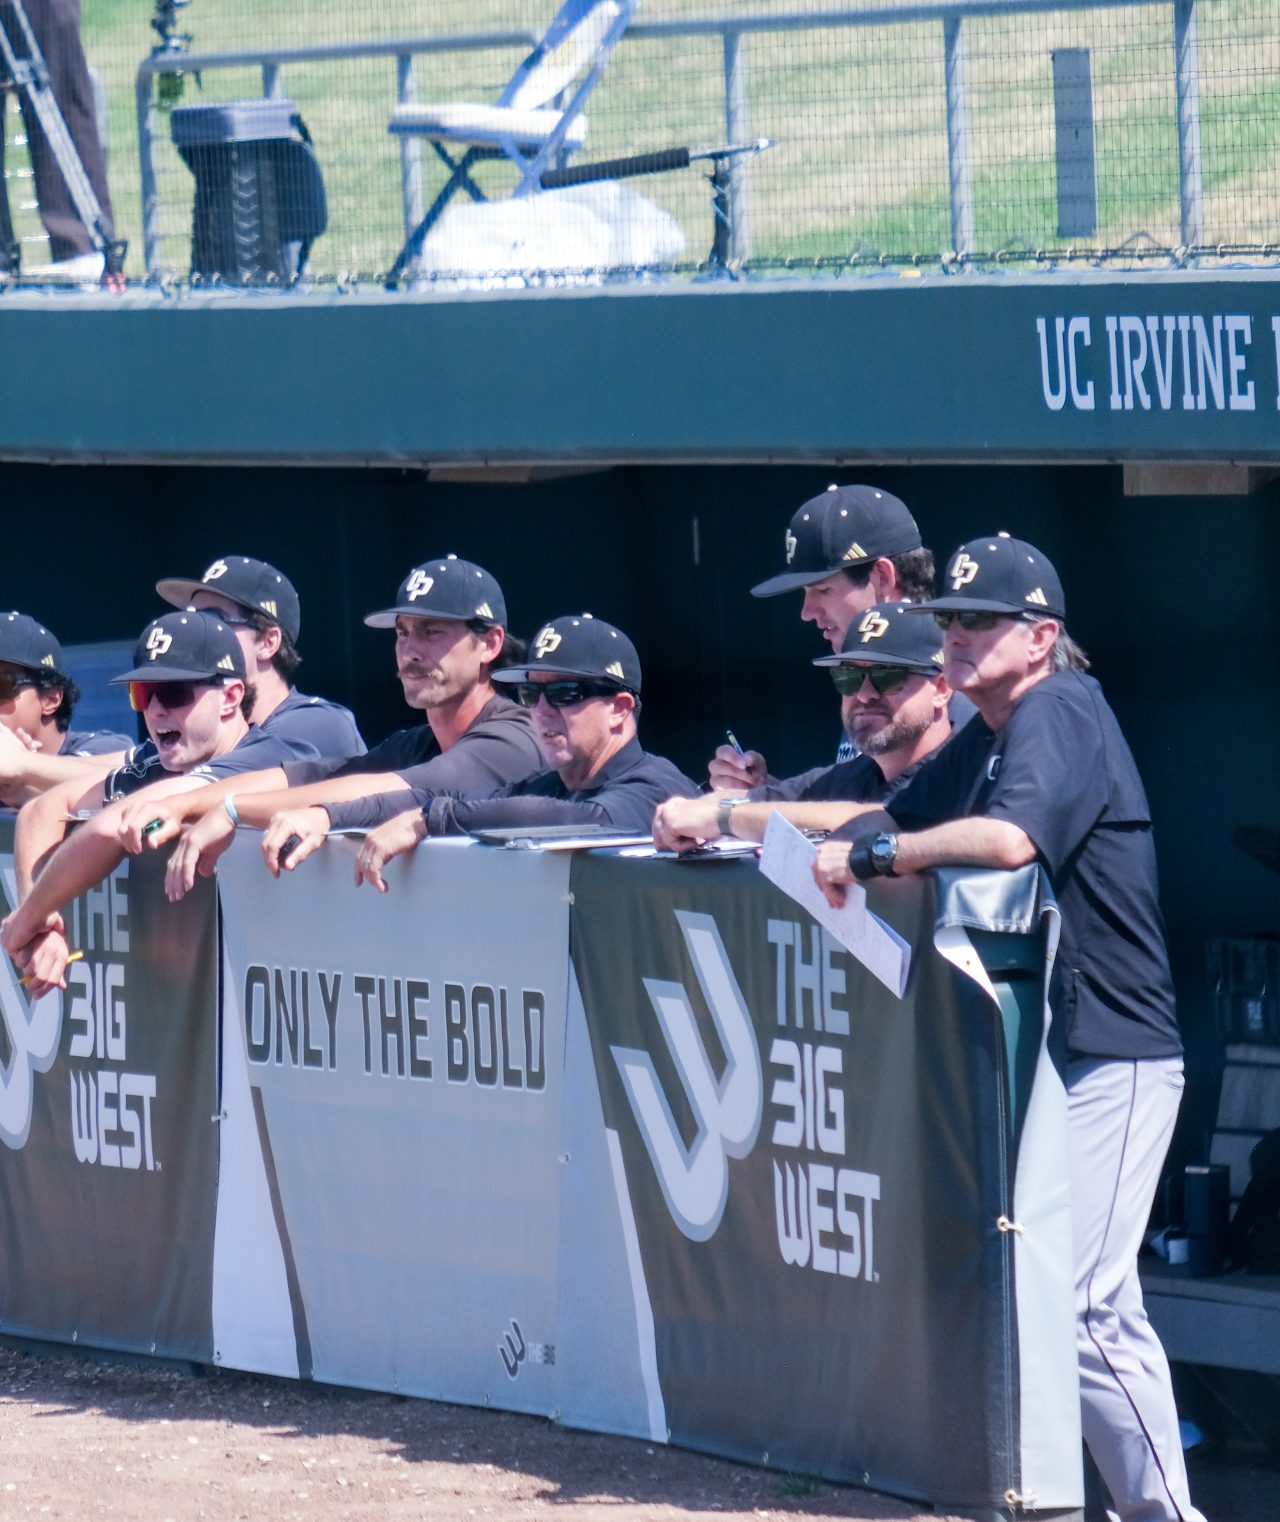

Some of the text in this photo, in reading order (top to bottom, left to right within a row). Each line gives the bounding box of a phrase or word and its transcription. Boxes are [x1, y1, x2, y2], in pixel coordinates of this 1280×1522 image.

[1036, 316, 1095, 410] UC
[1105, 315, 1256, 411] IRVINE
[244, 963, 547, 1095] ONLY THE BOLD
[767, 918, 850, 1036] THE
[70, 1069, 156, 1171] WEST
[773, 1158, 881, 1283] WEST
